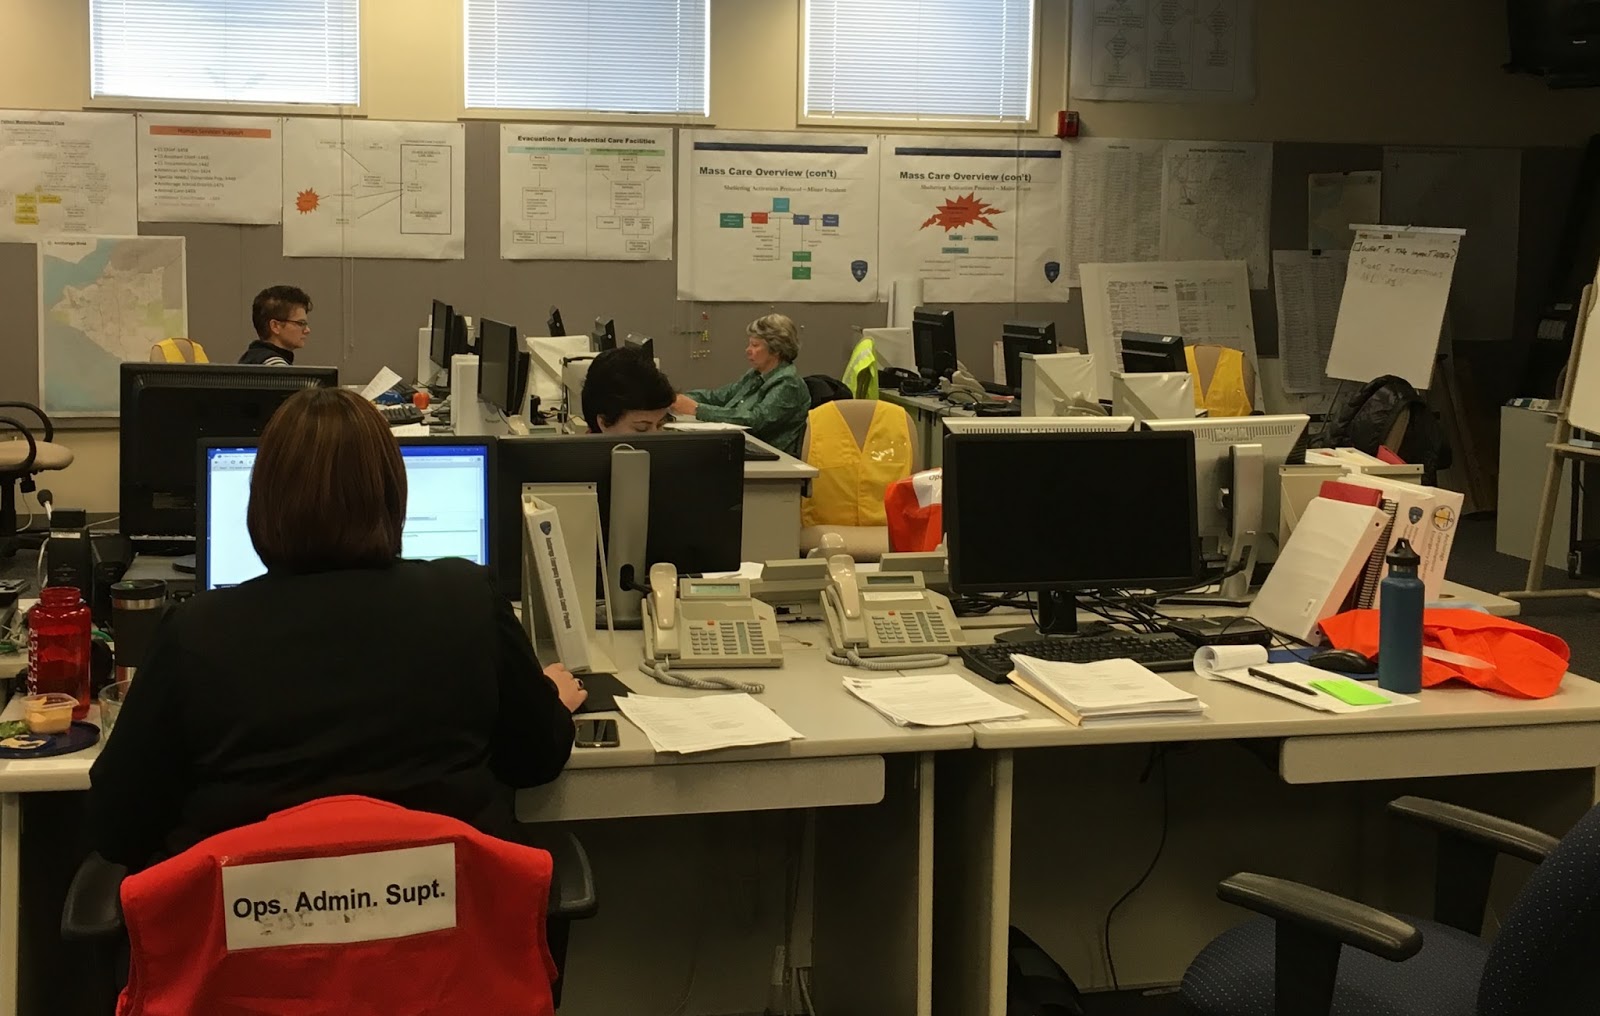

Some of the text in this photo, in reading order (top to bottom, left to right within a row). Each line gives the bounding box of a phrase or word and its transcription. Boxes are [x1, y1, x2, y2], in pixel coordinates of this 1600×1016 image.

[699, 167, 837, 179] Mass Care Overview (con't)
[899, 172, 1032, 182] Mass Care Overview (con't)
[233, 879, 446, 922] Ops. Admin. Supt.
